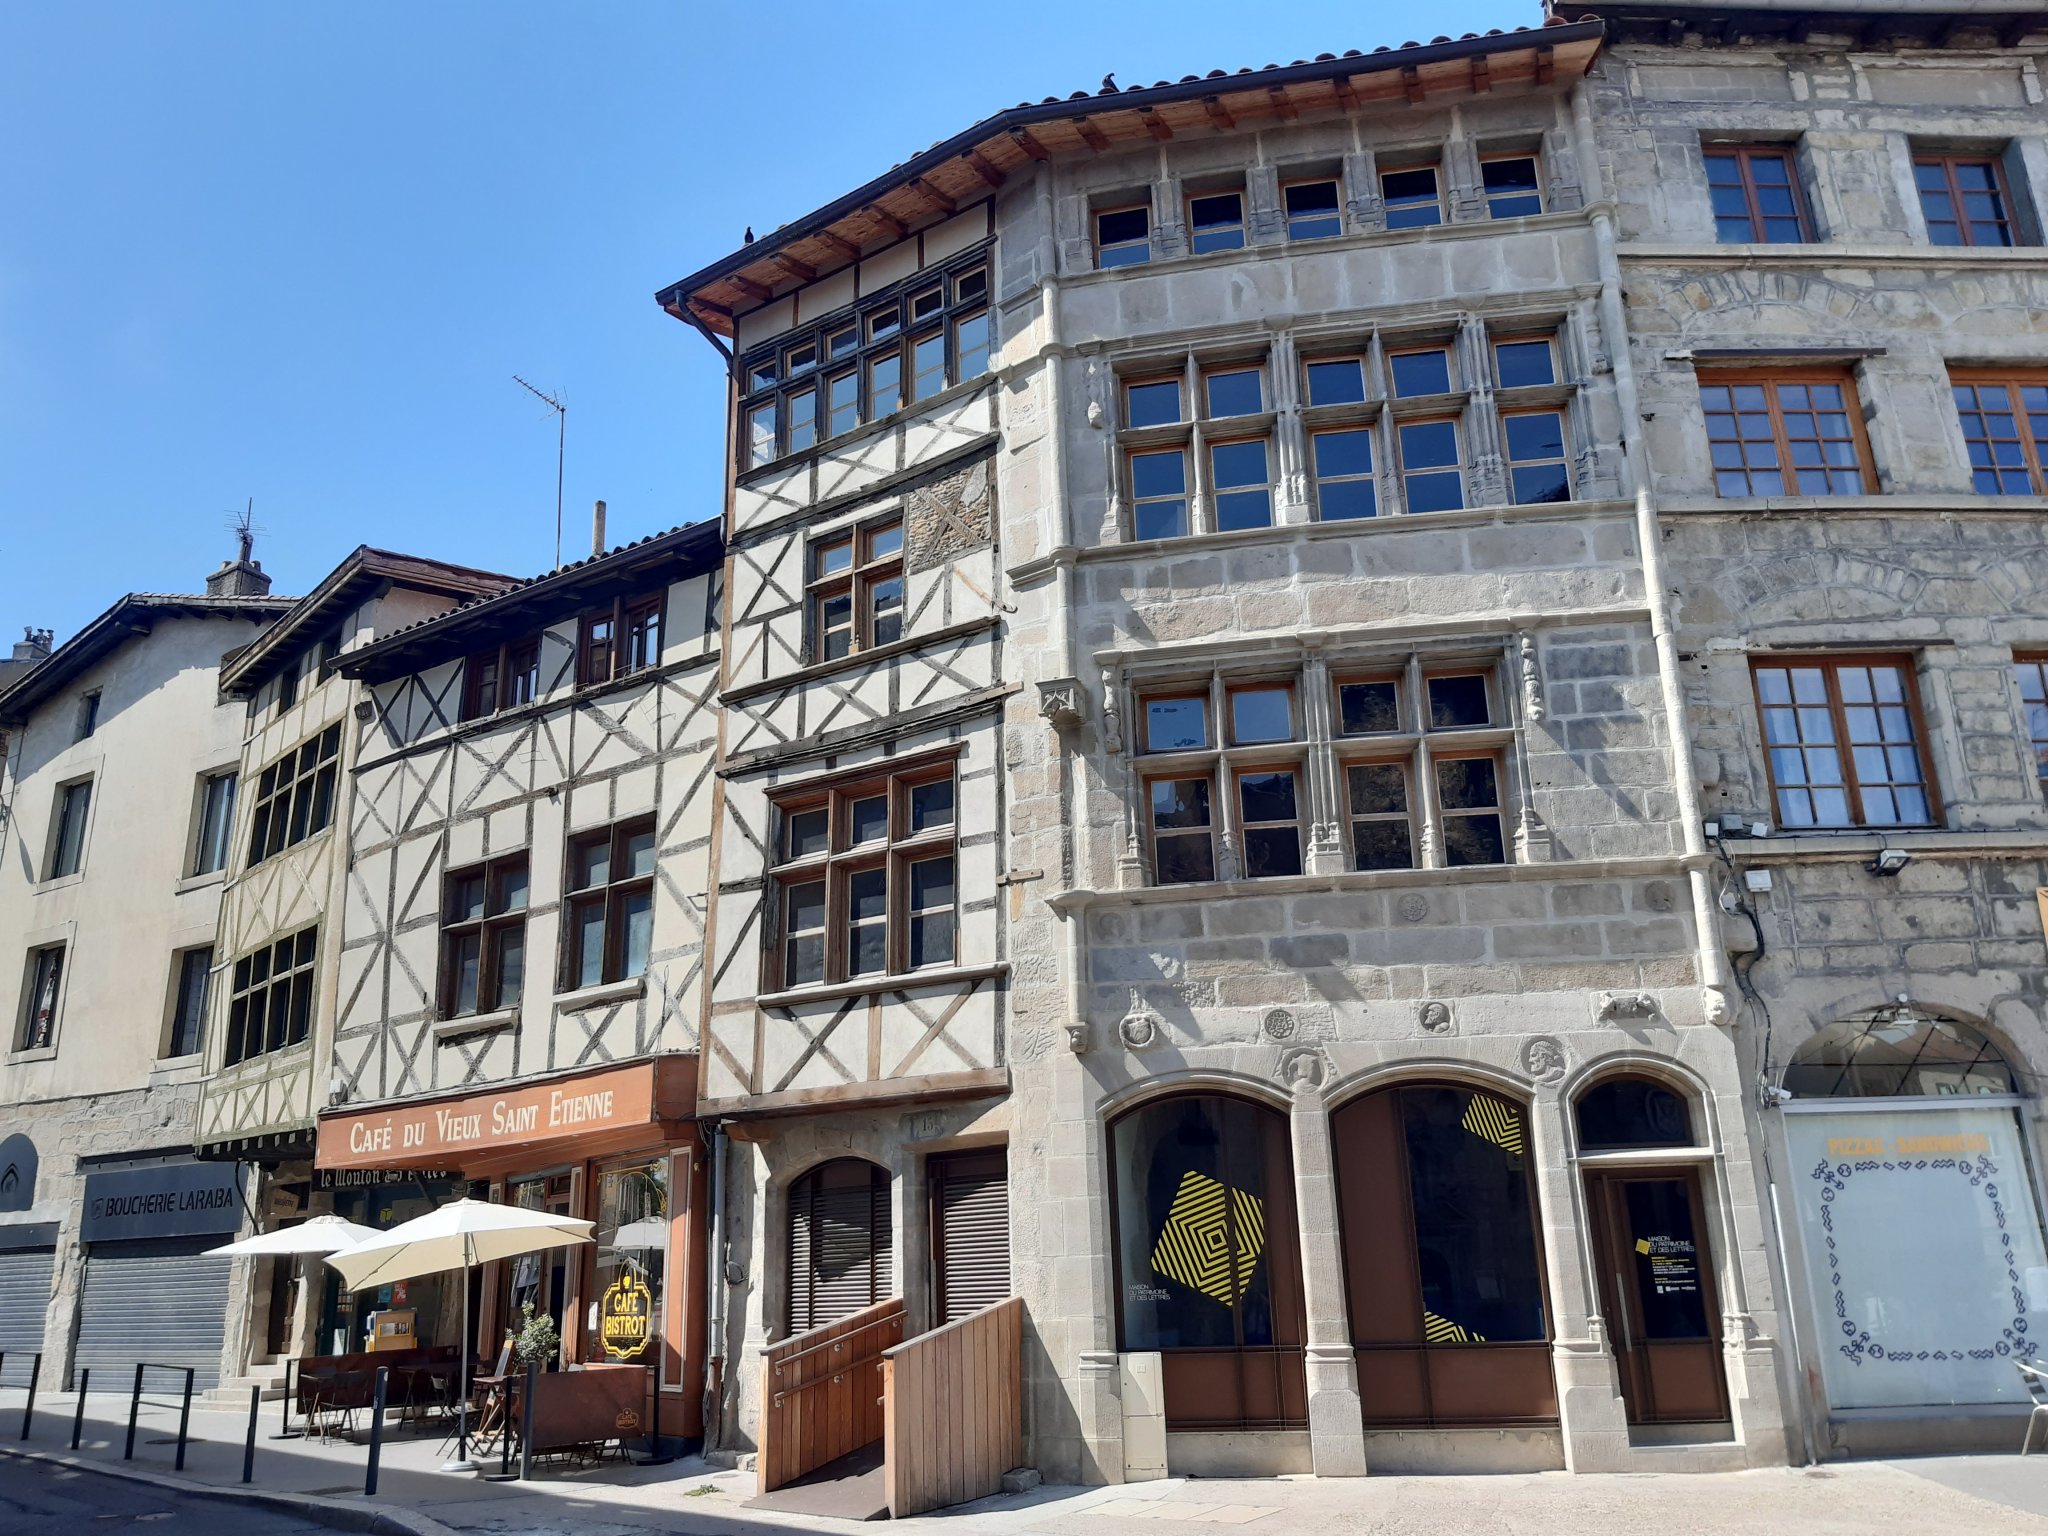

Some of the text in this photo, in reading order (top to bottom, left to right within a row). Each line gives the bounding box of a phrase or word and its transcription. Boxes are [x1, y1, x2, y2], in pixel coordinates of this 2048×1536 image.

[105, 1187, 233, 1217] BOUCHERIE LARABA
[605, 1315, 646, 1336] BISTROT
